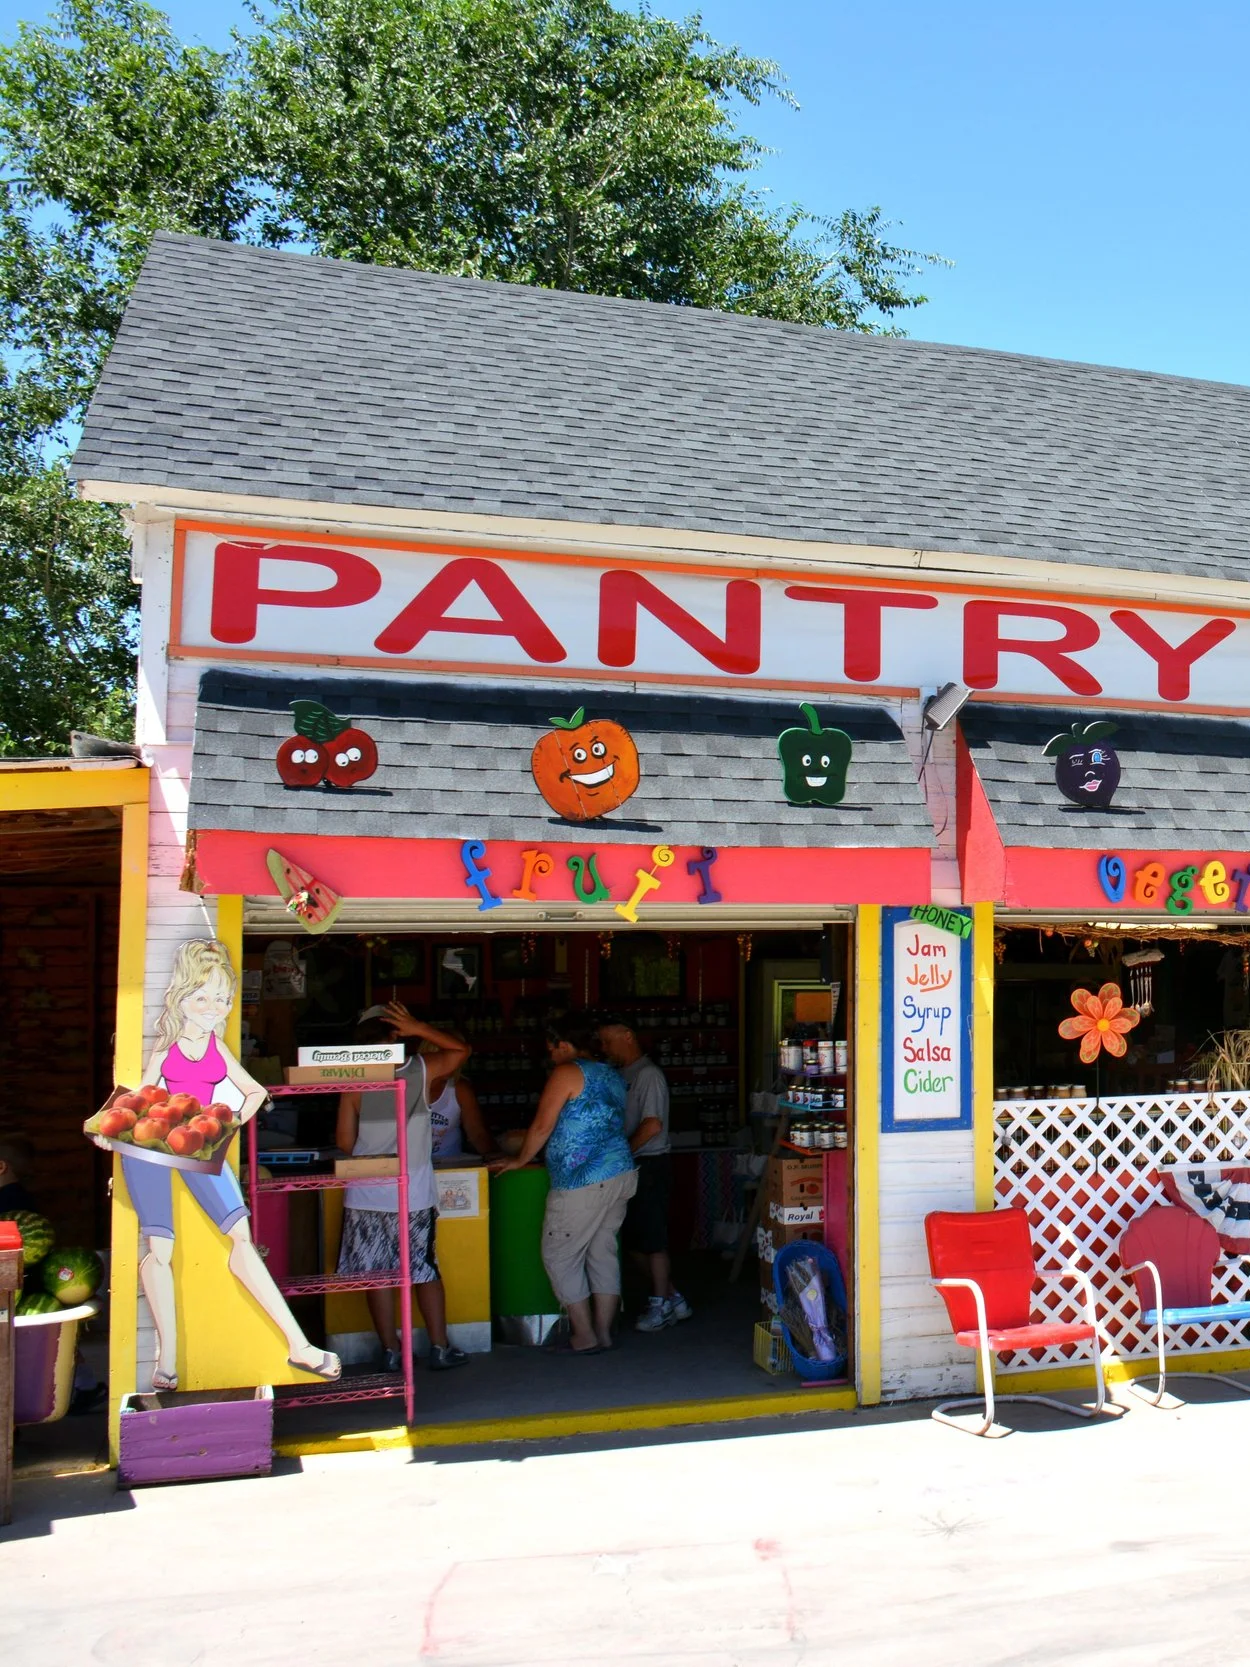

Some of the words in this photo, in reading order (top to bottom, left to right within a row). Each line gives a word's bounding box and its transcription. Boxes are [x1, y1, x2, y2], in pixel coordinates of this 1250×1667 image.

[210, 541, 1236, 701] PANTRY
[913, 905, 972, 936] HONEY
[906, 934, 946, 957] Jam
[906, 963, 953, 993] Jelly
[902, 995, 951, 1036] Syrup
[903, 1037, 951, 1063] Salsa
[903, 1068, 953, 1094] Cider
[787, 1211, 814, 1222] Royal
